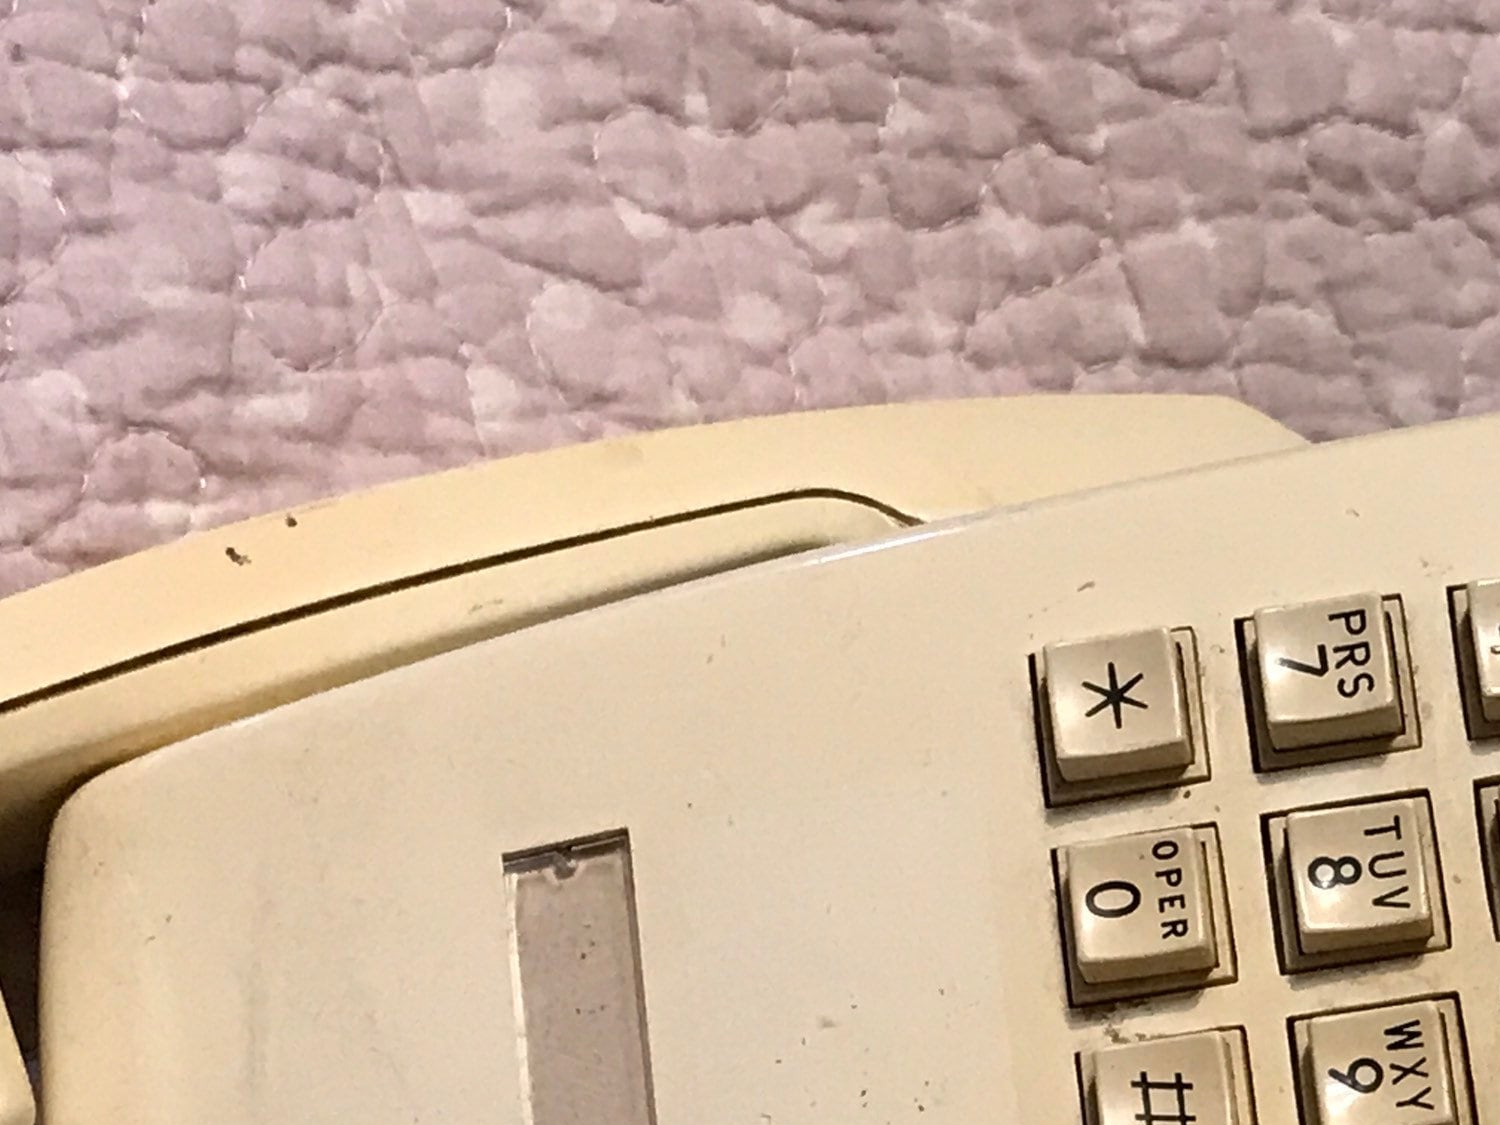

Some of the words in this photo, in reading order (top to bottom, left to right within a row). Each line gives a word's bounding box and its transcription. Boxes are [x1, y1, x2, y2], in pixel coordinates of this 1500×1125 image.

[1278, 643, 1329, 677] 7
[1328, 608, 1375, 699] PRS
[1151, 839, 1189, 940] OPER
[1307, 856, 1362, 889] 8
[1363, 815, 1411, 910] TUV
[1327, 1057, 1384, 1094] 9
[1383, 1019, 1435, 1111] WXY
